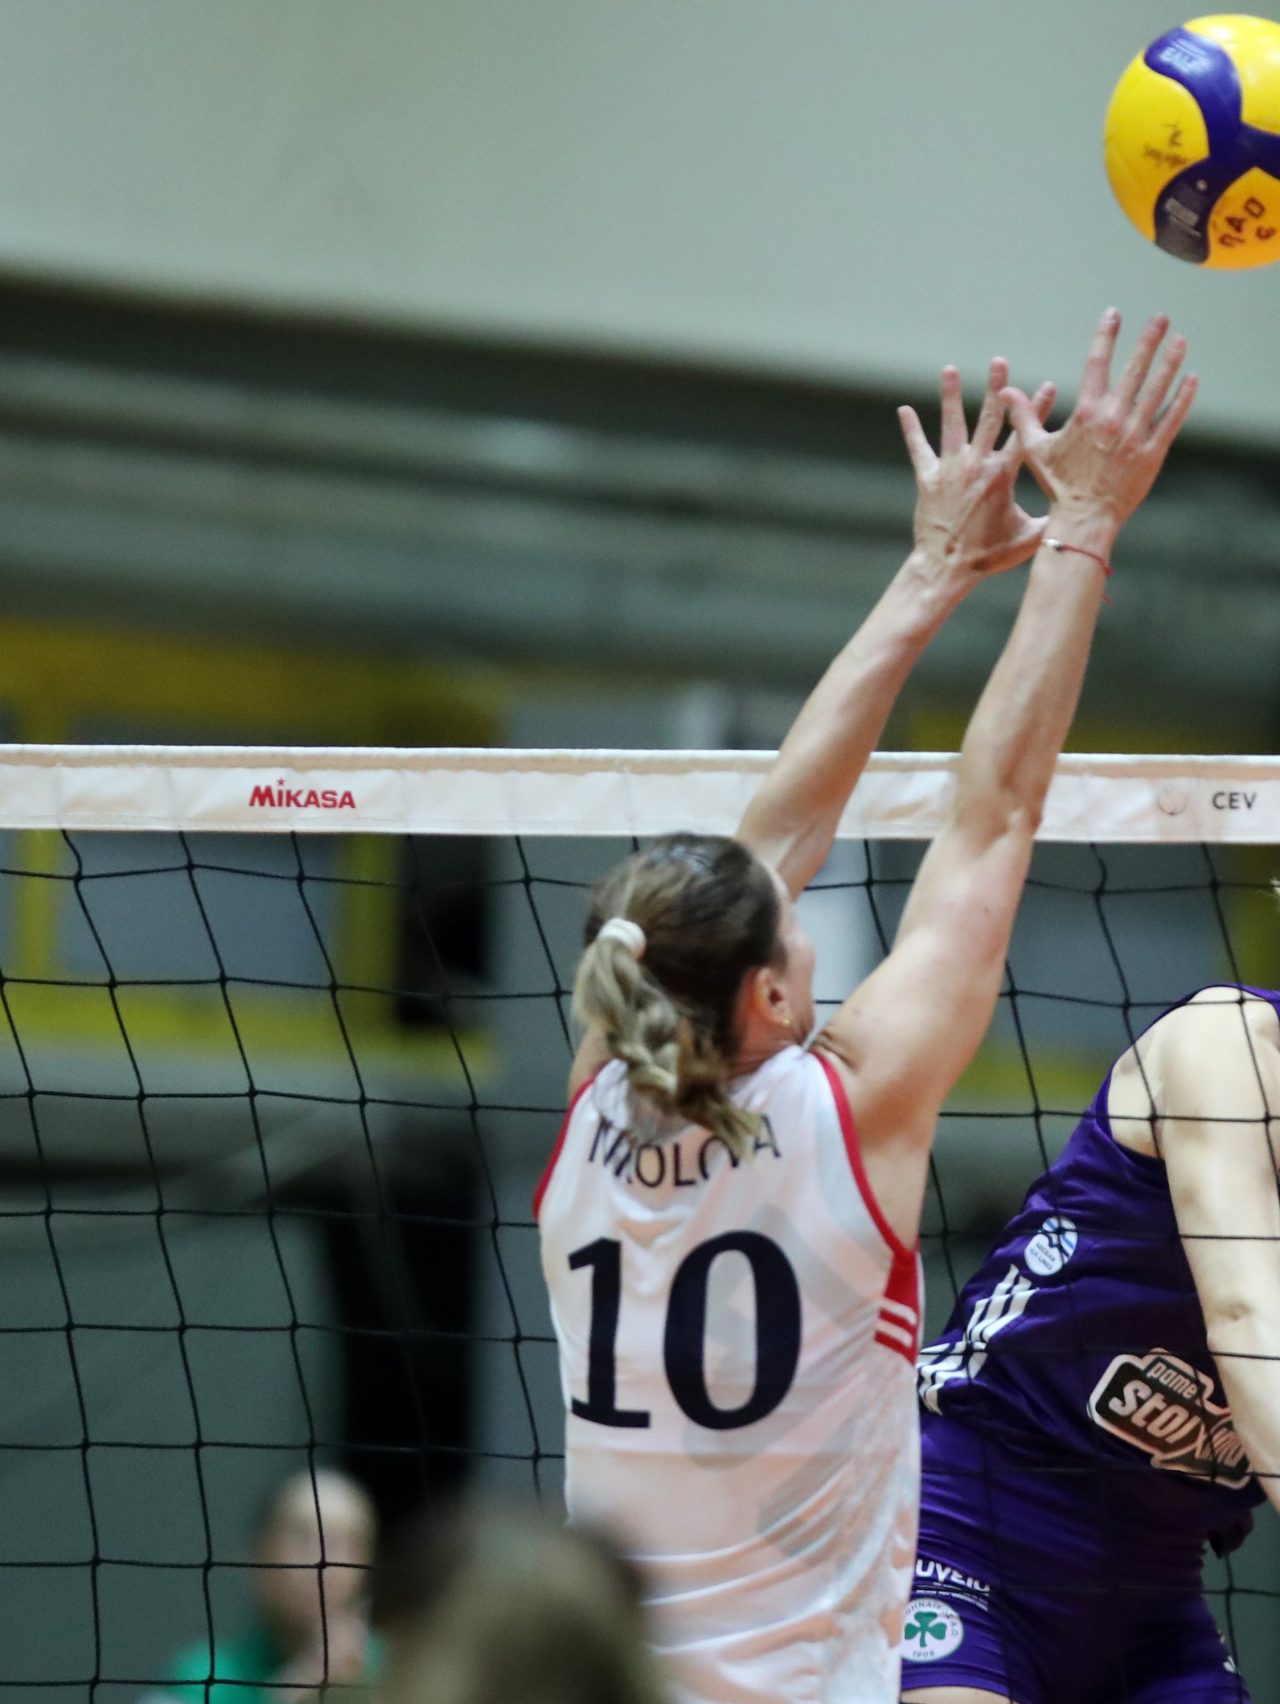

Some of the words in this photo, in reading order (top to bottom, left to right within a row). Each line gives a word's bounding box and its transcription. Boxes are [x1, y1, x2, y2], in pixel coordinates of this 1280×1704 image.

[1212, 791, 1257, 810] CEV
[569, 1230, 803, 1430] 10
[1146, 1362, 1199, 1399] pame
